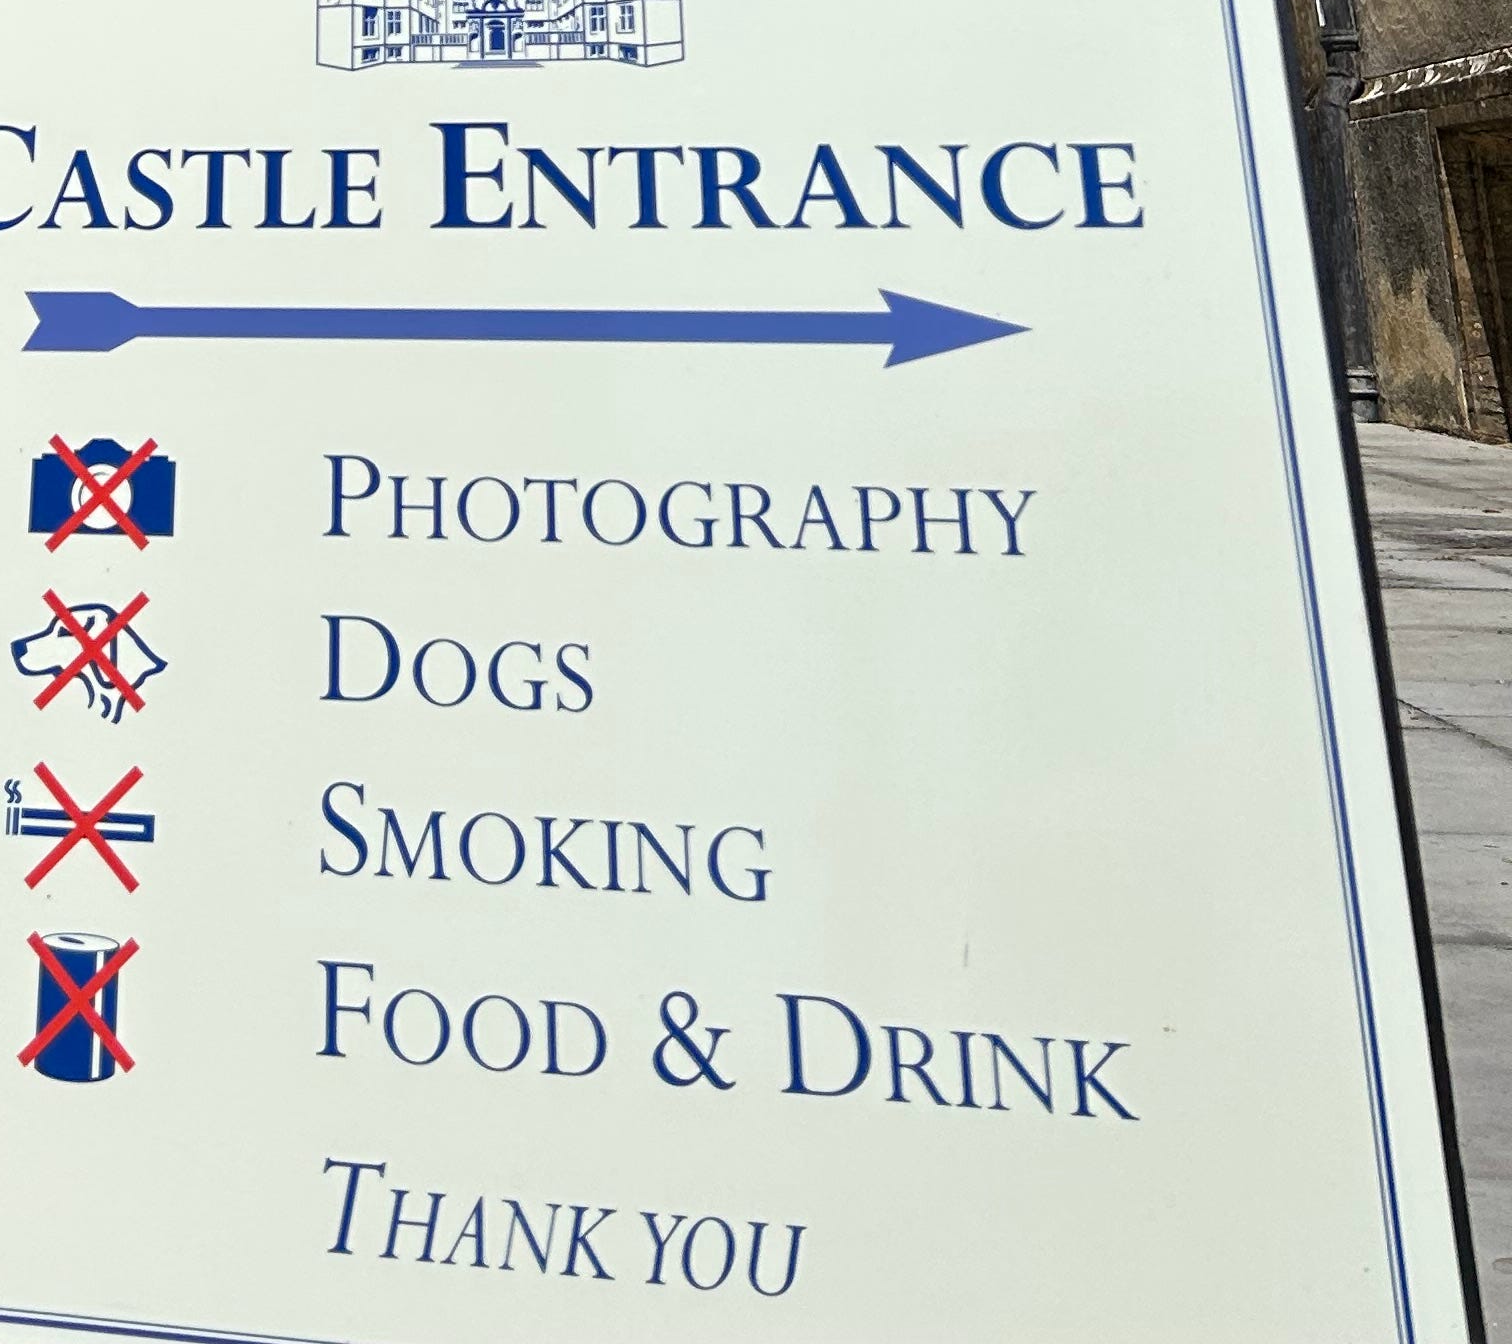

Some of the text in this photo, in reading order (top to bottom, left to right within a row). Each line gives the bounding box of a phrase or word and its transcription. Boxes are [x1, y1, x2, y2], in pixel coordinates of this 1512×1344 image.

[430, 122, 1144, 231] ENTRANCE
[322, 454, 1036, 557] PHOTOGRAPHY
[320, 615, 593, 713] DOGS
[321, 782, 772, 902] SMOKING
[318, 960, 1138, 1121] FOOD & DRINK
[323, 1157, 806, 1296] THANK YOU
